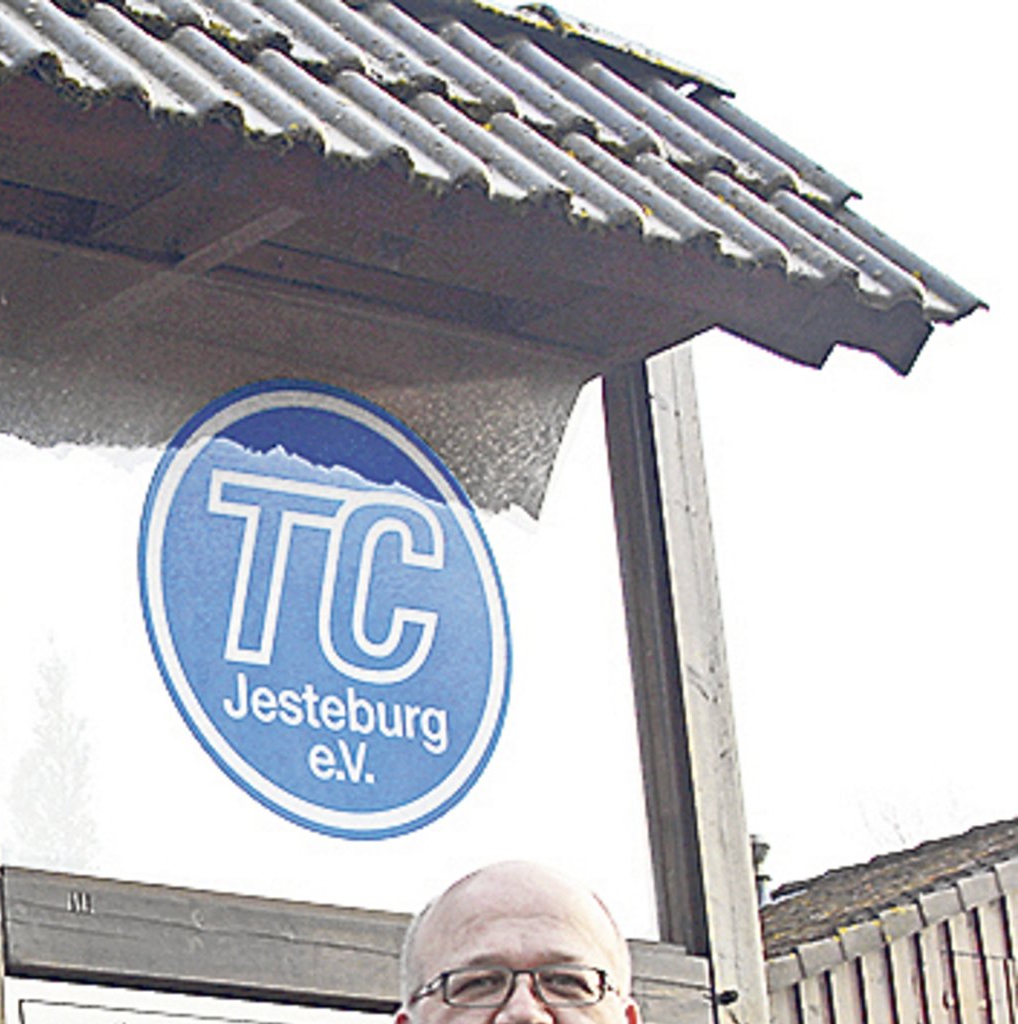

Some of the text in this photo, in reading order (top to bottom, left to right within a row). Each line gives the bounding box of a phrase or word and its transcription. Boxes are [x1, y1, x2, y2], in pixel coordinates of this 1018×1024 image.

[207, 468, 445, 685] TC
[222, 672, 449, 755] Jesteburg
[308, 738, 375, 785] e.V.
